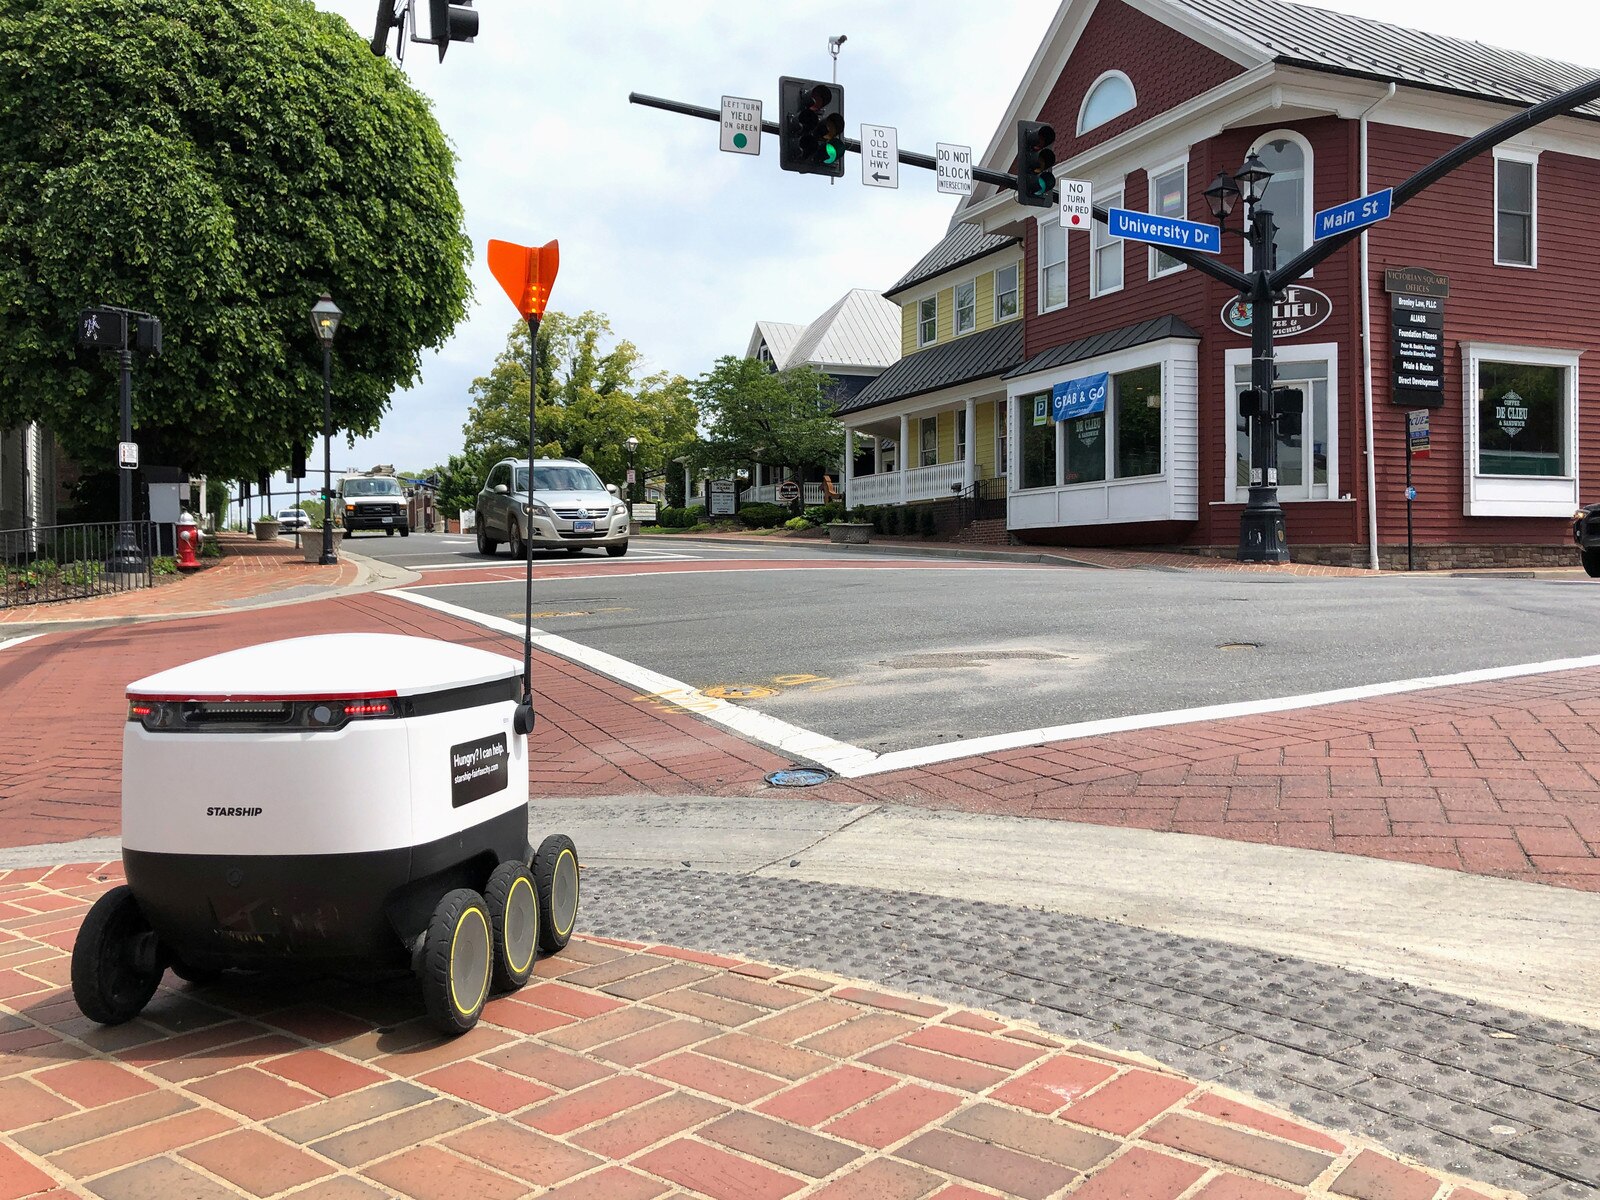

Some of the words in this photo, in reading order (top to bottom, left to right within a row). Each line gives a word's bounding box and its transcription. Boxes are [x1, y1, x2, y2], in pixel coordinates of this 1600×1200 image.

[723, 100, 739, 109] LEFT
[741, 102, 760, 112] TURN
[731, 111, 753, 122] YIELD
[724, 121, 733, 129] ON
[736, 123, 758, 132] GREEN
[873, 129, 885, 138] TO
[870, 139, 889, 149] OLD
[871, 150, 889, 159] LEE
[938, 149, 950, 161] DO
[953, 152, 970, 164] NOT
[870, 160, 890, 169] HWY
[939, 165, 970, 180] BLOCK
[939, 180, 971, 191] INTERSECTION
[1069, 183, 1084, 194] NO
[1067, 195, 1086, 204] TURN
[1062, 204, 1073, 213] ON
[1075, 206, 1089, 215] RED
[1323, 210, 1355, 231] Main
[1361, 200, 1379, 218] St
[1119, 215, 1190, 244] University
[1194, 228, 1210, 244] Dr
[1388, 271, 1422, 281] VICTORIAN
[1423, 276, 1447, 286] SQUARE
[1405, 283, 1430, 293] OFFICES
[1415, 299, 1426, 309] Law,
[1426, 300, 1437, 309] PLLC
[1273, 303, 1318, 319] LIEU
[1410, 314, 1427, 323] ALIASS
[1273, 325, 1302, 334] WICHES
[1399, 329, 1421, 339] Foundation
[1422, 331, 1438, 340] Fitness
[1398, 376, 1411, 385] Direct
[1412, 377, 1439, 388] Development
[1055, 394, 1077, 408] GRAB
[1079, 391, 1086, 403] &
[1088, 386, 1105, 401] GO
[1038, 402, 1044, 415] P
[1496, 406, 1506, 419] DE
[1507, 407, 1528, 420] CLIEU
[1076, 420, 1084, 433] DE
[1410, 416, 1425, 426] CUE
[453, 748, 480, 768] Hungry?
[480, 748, 482, 760] I
[483, 748, 492, 759] can
[493, 742, 504, 757] help.
[454, 763, 499, 784] starship-fairfaxcity.com
[206, 807, 263, 817] STARSHIP
